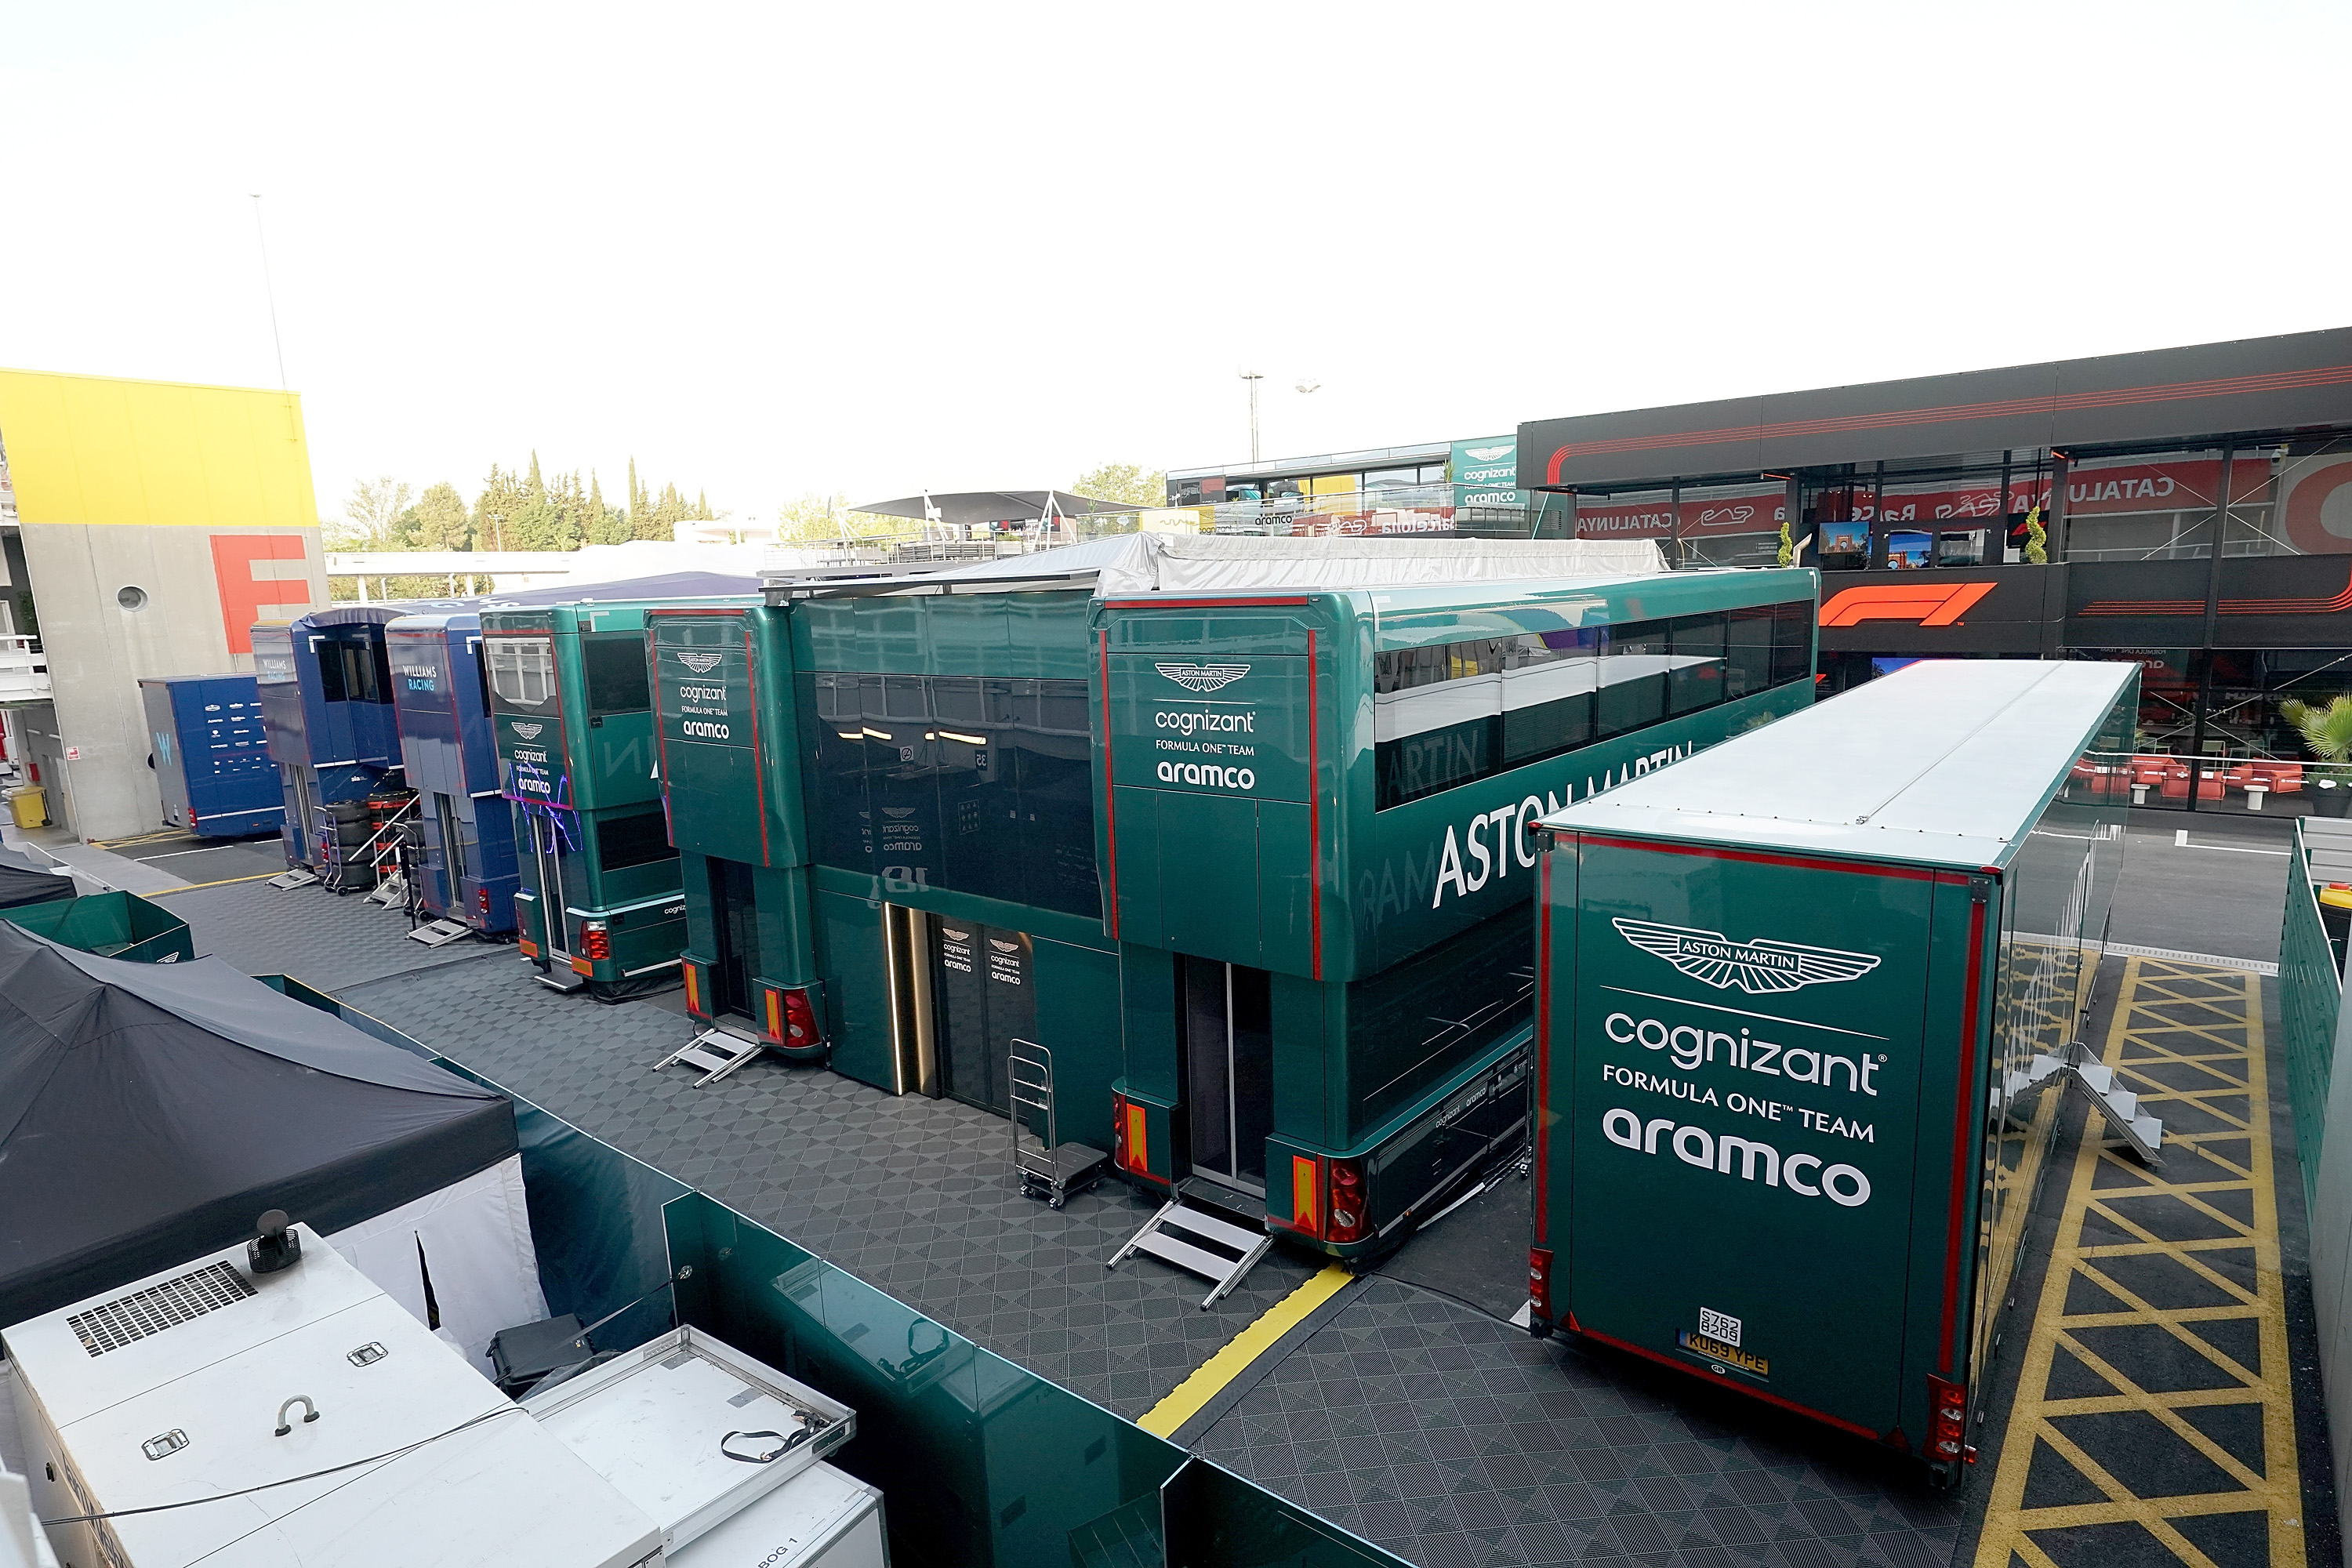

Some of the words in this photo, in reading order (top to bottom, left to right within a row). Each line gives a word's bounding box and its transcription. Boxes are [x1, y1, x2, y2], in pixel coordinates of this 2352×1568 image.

[1464, 466, 1516, 482] cognizant
[1465, 491, 1516, 504] aramco
[1254, 514, 1293, 526] aramco
[263, 659, 287, 670] WILLIAMS
[402, 665, 437, 678] WILLIAMS
[408, 678, 434, 691] RACING
[680, 684, 727, 703] cognizant
[681, 705, 703, 714] FORMULA
[683, 720, 730, 739] aramco
[1155, 709, 1256, 736] cognizant
[514, 749, 548, 764] cognizant
[1156, 739, 1200, 753] FORMULA
[1228, 744, 1254, 757] TEAM
[1156, 760, 1255, 789] aramco
[518, 778, 551, 794] aramco
[943, 943, 971, 956] cognizant
[1682, 938, 1731, 959] ASTON
[1734, 948, 1795, 970] MARTIN
[944, 959, 972, 973] aramco
[990, 955, 1020, 967] cognizant
[991, 971, 1021, 985] aramco
[1465, 1087, 1486, 1107] aramco
[1603, 1064, 1719, 1107] FORMULA
[1798, 1107, 1875, 1143] TEAM
[1436, 1105, 1461, 1128] cognizant
[1602, 1108, 1871, 1207] aramco
[1701, 1310, 1739, 1333] S762
[1700, 1320, 1738, 1342] 8209
[1689, 1334, 1730, 1358] KU69
[1734, 1348, 1766, 1371] YPE
